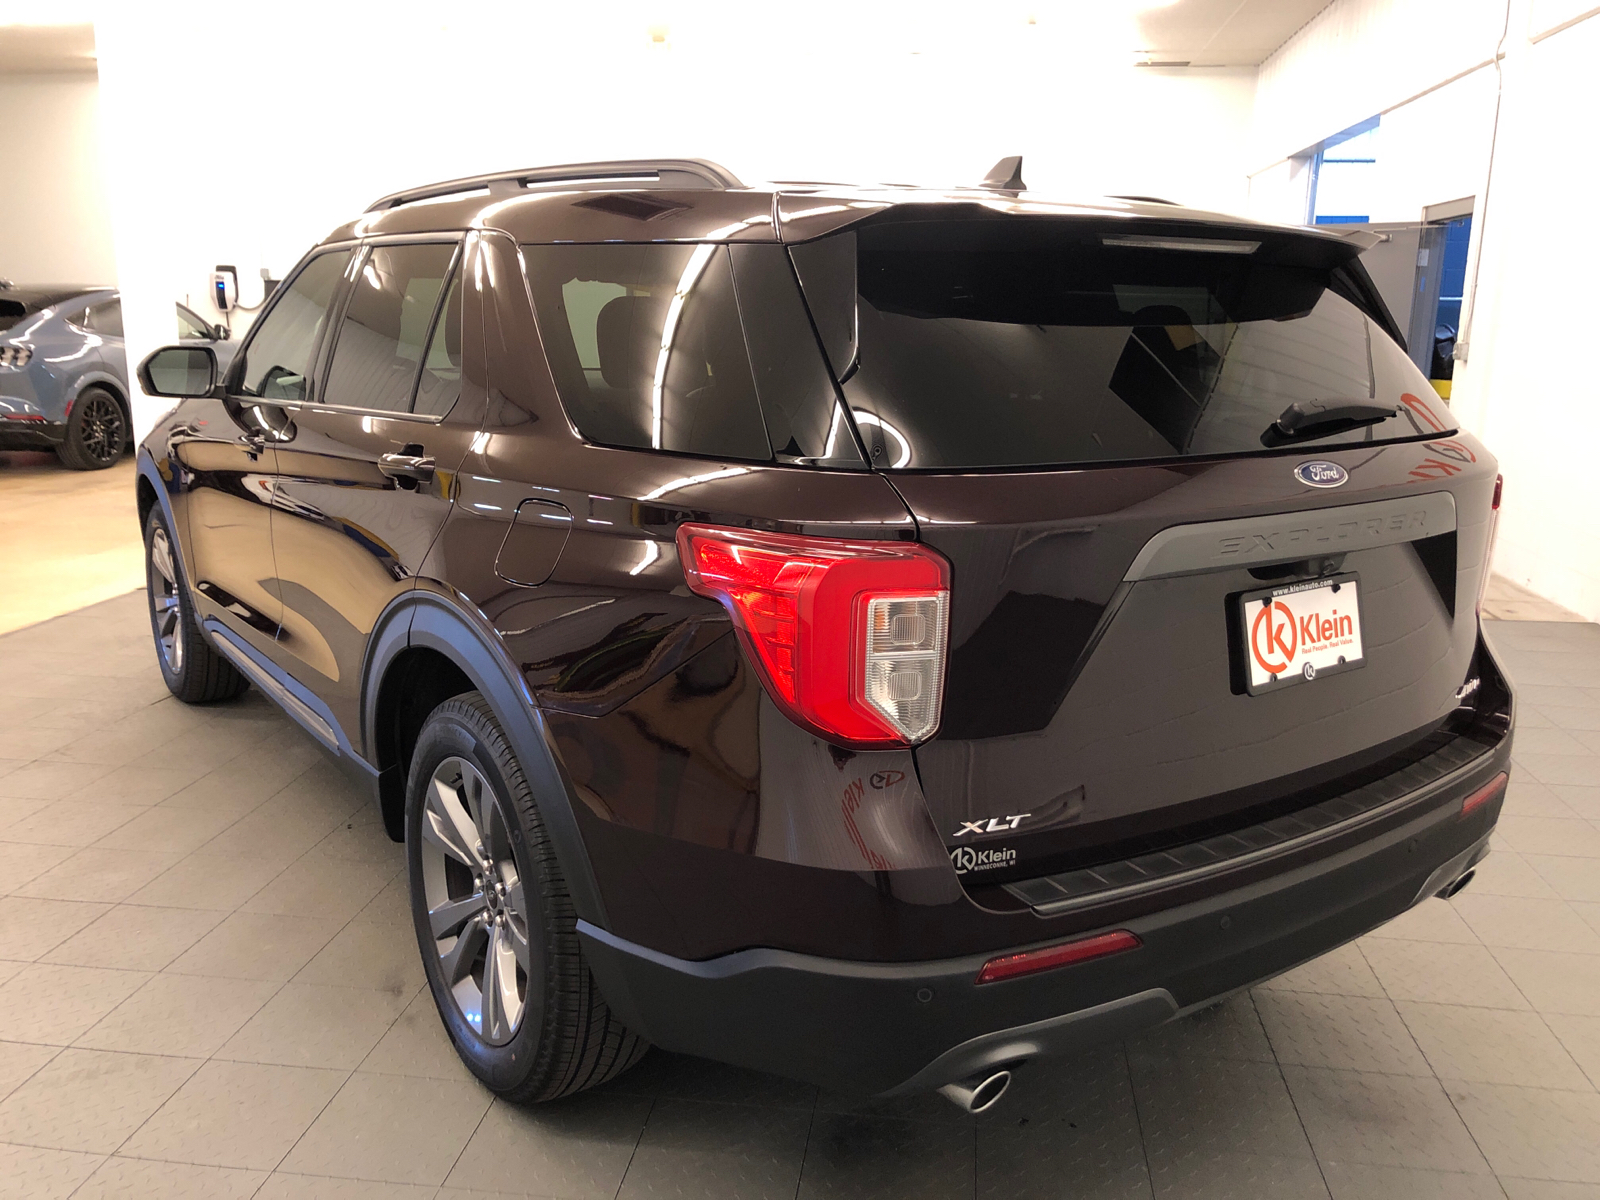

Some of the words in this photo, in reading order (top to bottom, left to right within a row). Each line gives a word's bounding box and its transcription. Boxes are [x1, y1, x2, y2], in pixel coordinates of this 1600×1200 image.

[1309, 464, 1340, 481] Ford
[1214, 511, 1427, 557] EXPLORER
[1272, 580, 1333, 596] www.kleinauto.com
[1300, 609, 1353, 646] Klein
[1312, 643, 1328, 651] People.
[1329, 640, 1339, 648] Real
[1340, 637, 1354, 646] Value.
[953, 813, 1032, 837] XLT
[977, 848, 1017, 864] Klein
